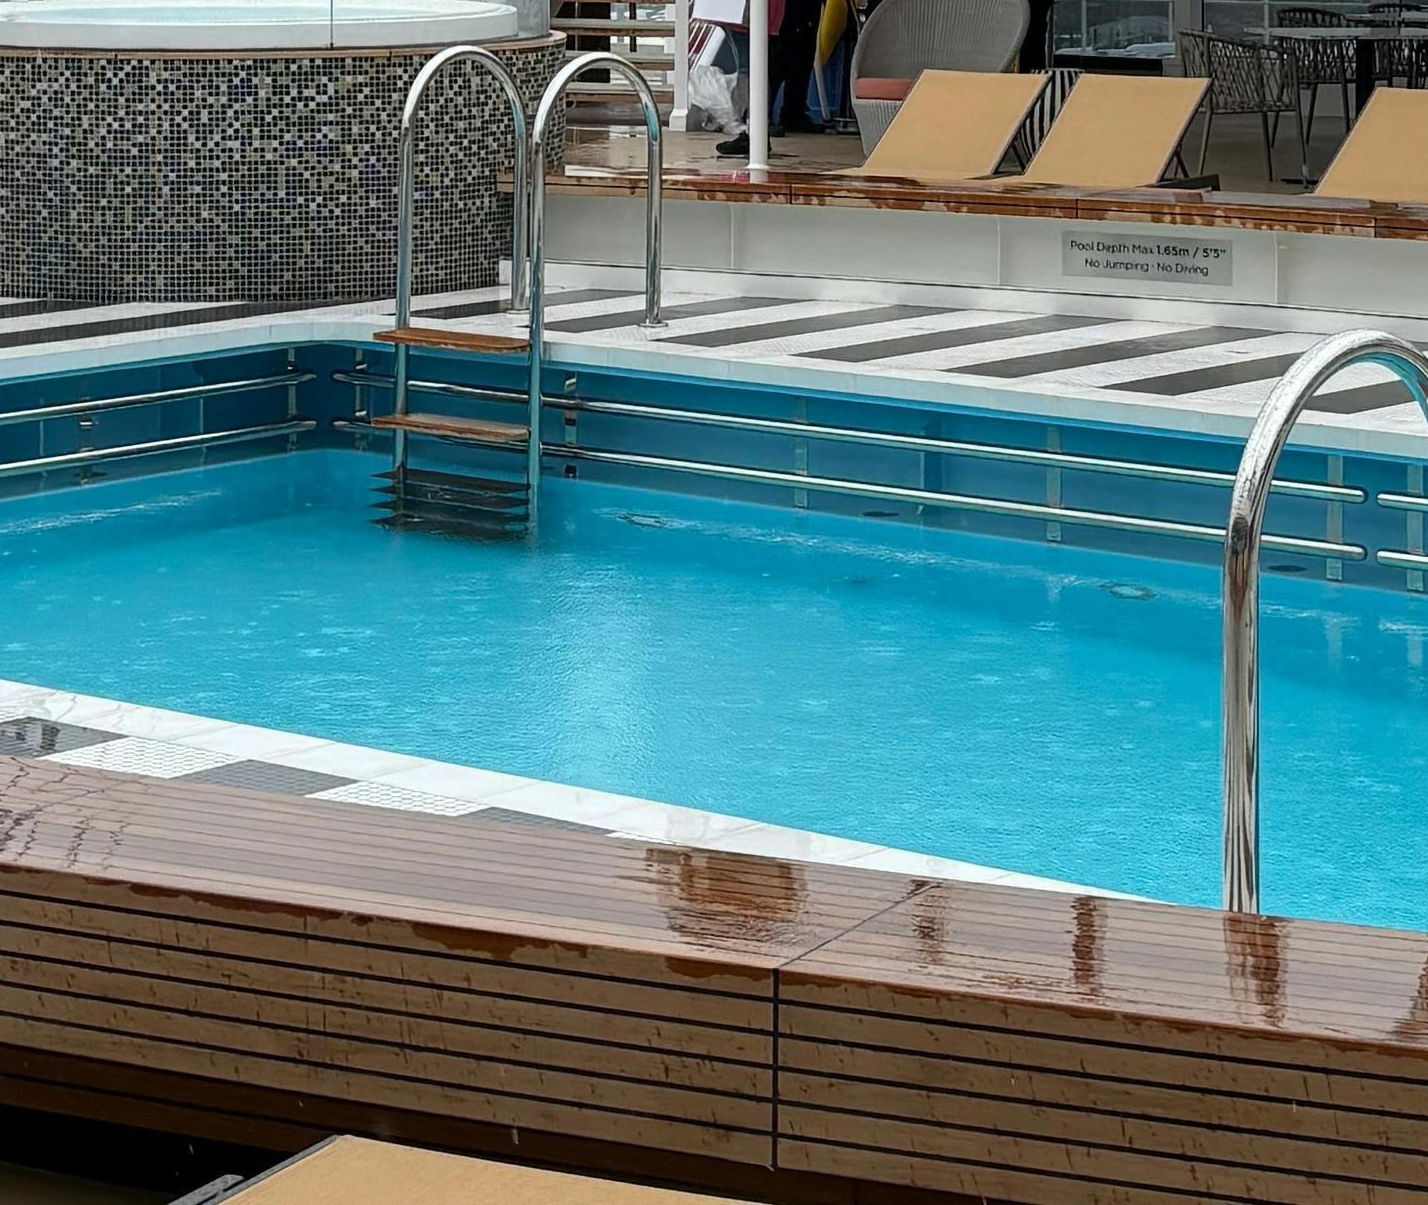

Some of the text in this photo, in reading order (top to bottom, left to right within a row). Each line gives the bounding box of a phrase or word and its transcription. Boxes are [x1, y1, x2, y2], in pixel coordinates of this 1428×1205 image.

[1157, 245, 1190, 257] 1.65m
[1085, 259, 1100, 268] No
[1103, 260, 1149, 273] Jumping
[1157, 263, 1172, 273] No
[1175, 264, 1209, 276] Diving
